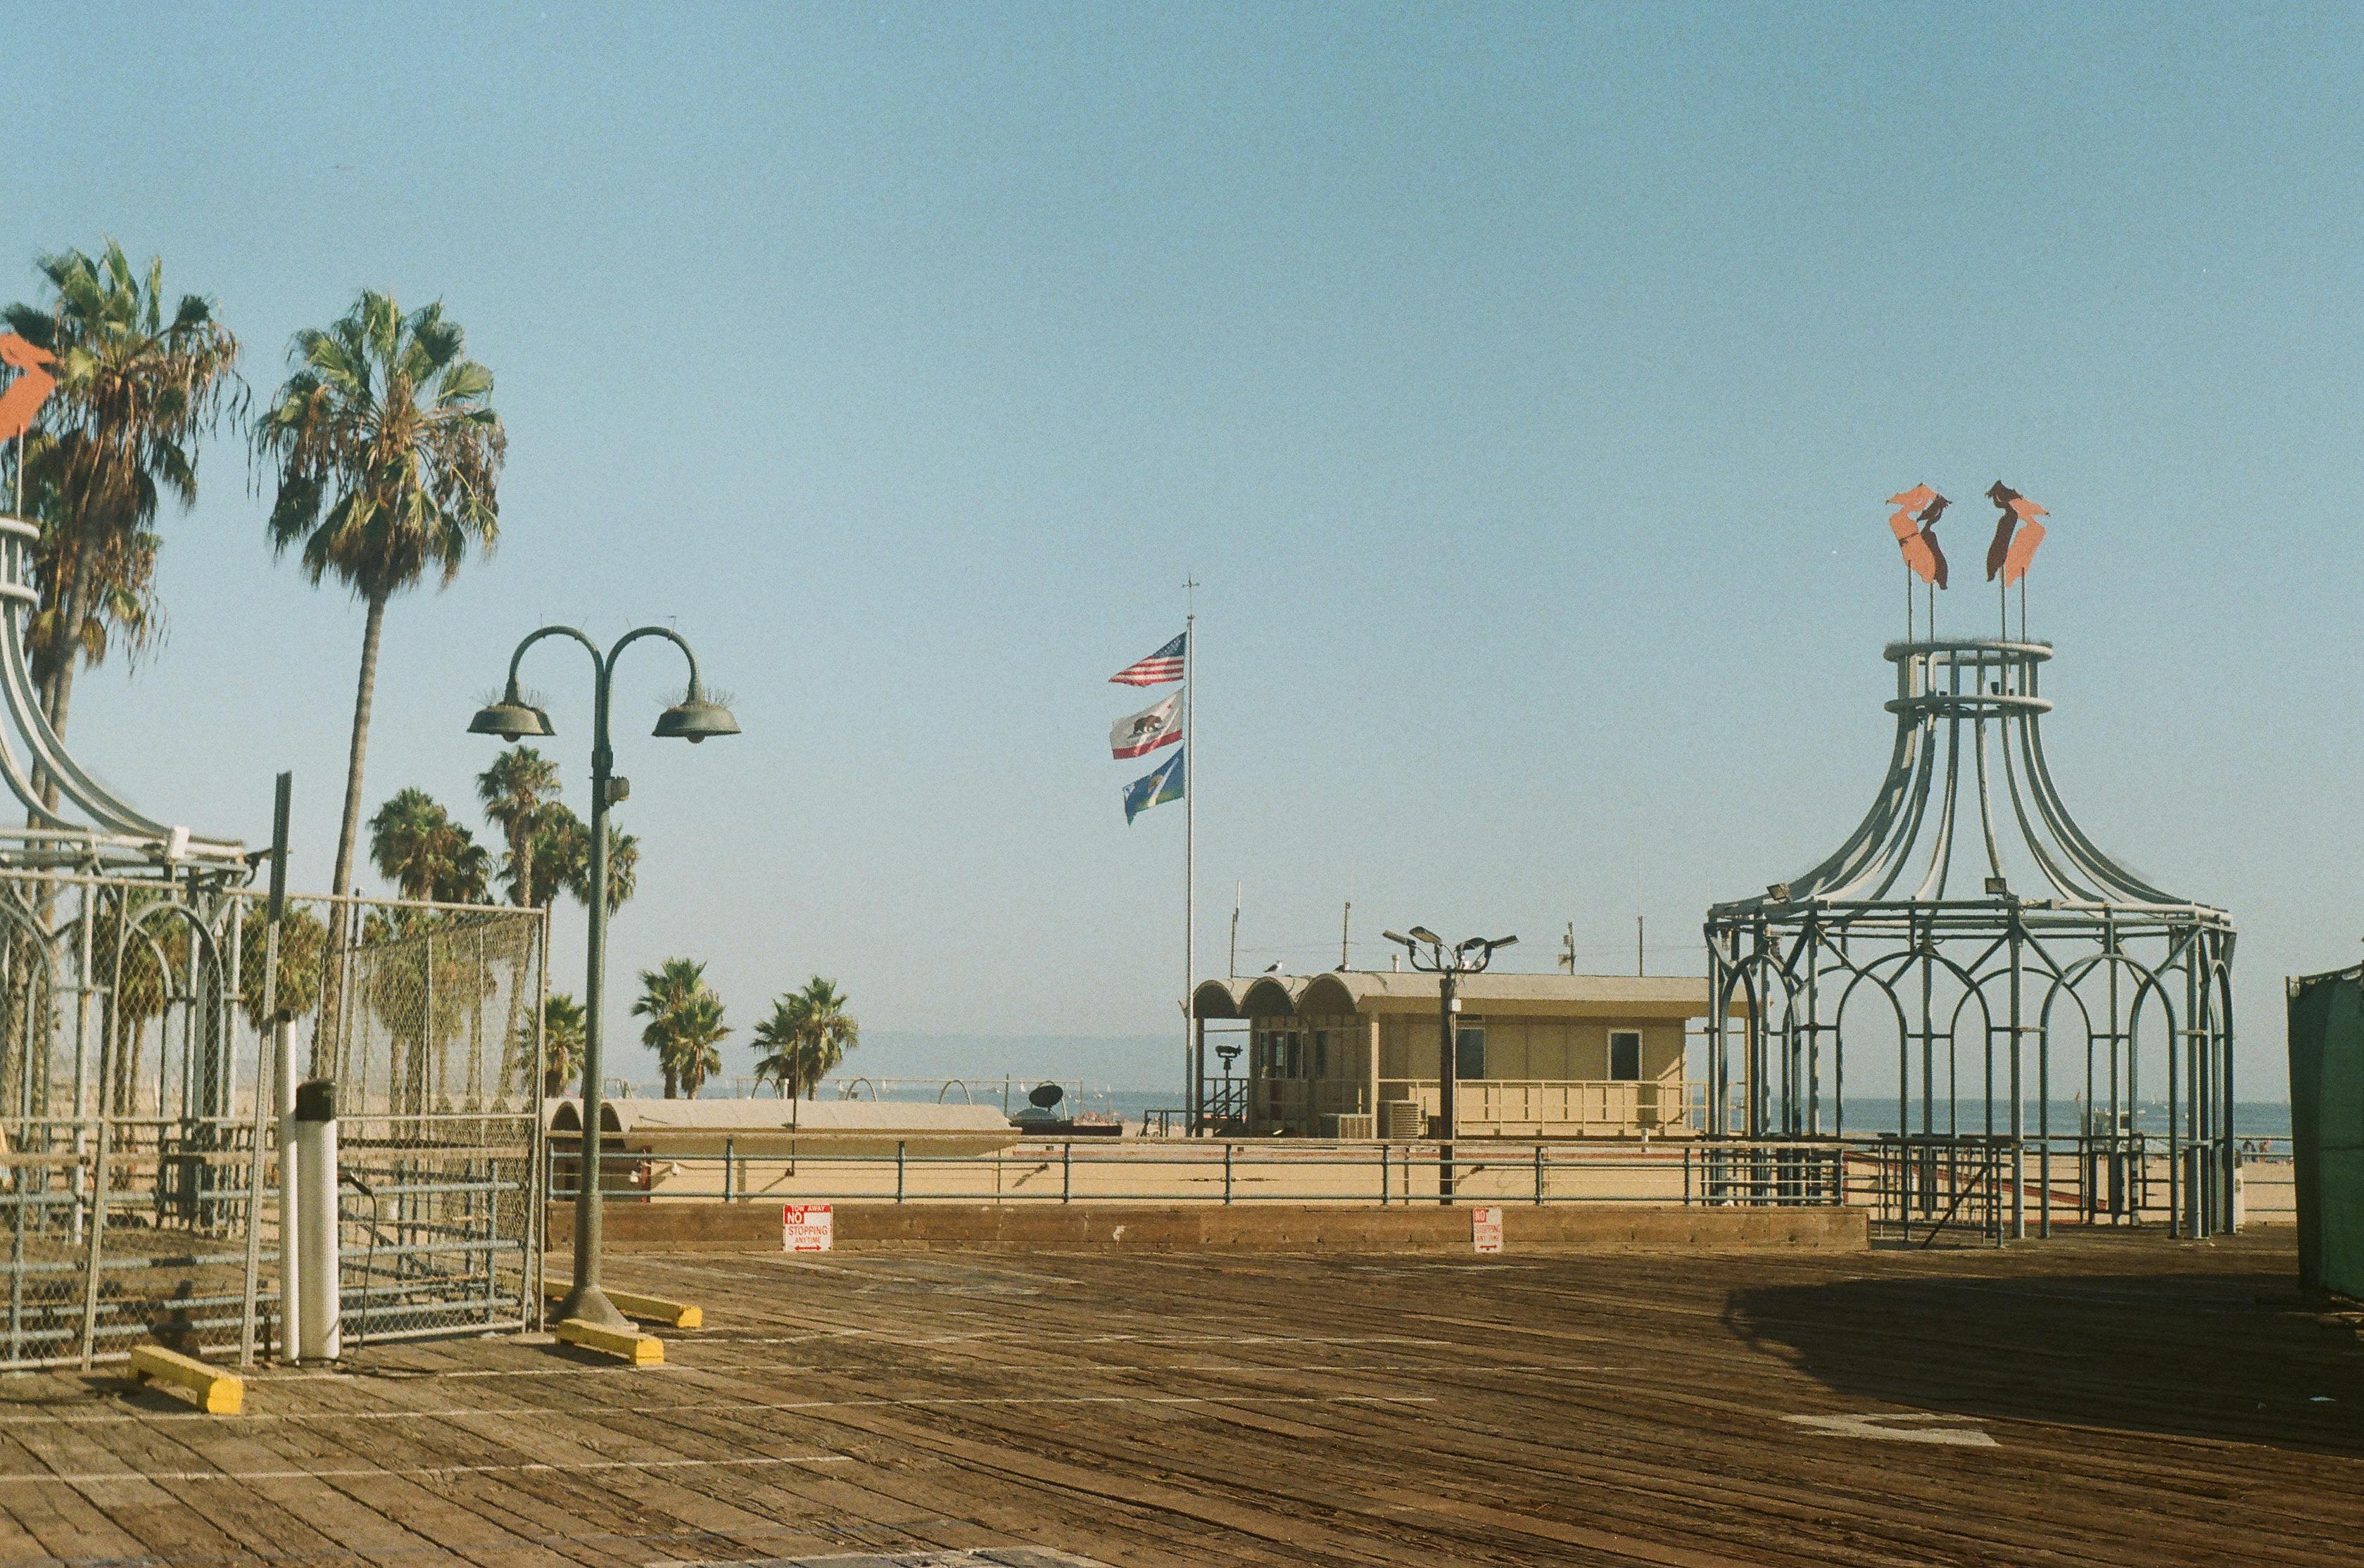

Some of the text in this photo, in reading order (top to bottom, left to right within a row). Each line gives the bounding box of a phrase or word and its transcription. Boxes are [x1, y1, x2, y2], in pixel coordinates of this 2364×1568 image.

[787, 1212, 802, 1224] NO
[1474, 1210, 1485, 1221] NO
[788, 1225, 828, 1235] STOPPING
